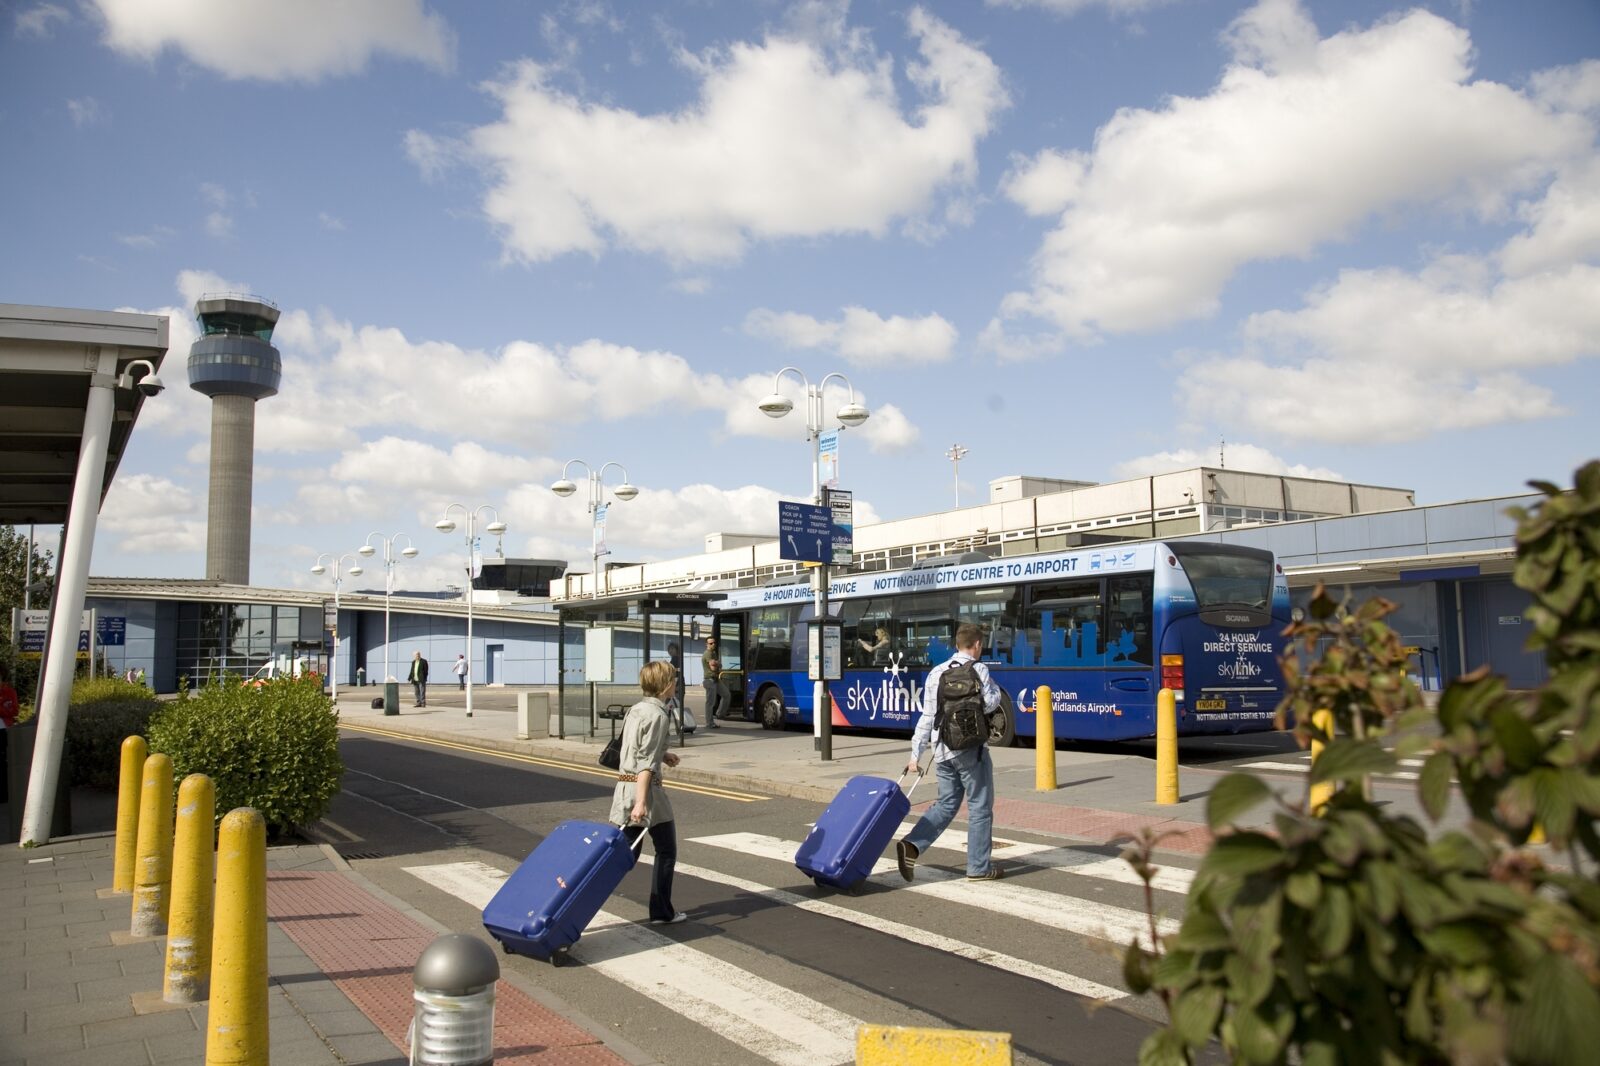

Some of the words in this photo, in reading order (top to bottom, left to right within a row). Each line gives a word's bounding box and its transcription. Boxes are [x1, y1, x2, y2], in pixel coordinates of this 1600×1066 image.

[873, 572, 935, 590] NOTTINGHAM
[935, 570, 959, 584] CITY
[961, 565, 1004, 582] CENTRE
[1007, 563, 1022, 577] TO
[1024, 557, 1079, 575] AIRPORT
[763, 591, 772, 601] 24
[772, 589, 793, 600] HOUR
[1225, 614, 1250, 622] SCANIA
[1219, 632, 1230, 642] 24
[1231, 633, 1256, 643] HOUR
[1203, 642, 1235, 652] DIRECT
[1237, 643, 1273, 653] SERVICE
[1218, 661, 1256, 679] skylink
[846, 679, 924, 721] skylink
[1032, 690, 1078, 702] Nngham
[1087, 703, 1117, 715] Airport
[882, 711, 911, 721] nottingham
[1196, 712, 1228, 721] NOTTINGHAM
[1228, 712, 1240, 720] CITY
[1240, 712, 1259, 720] CENTRE
